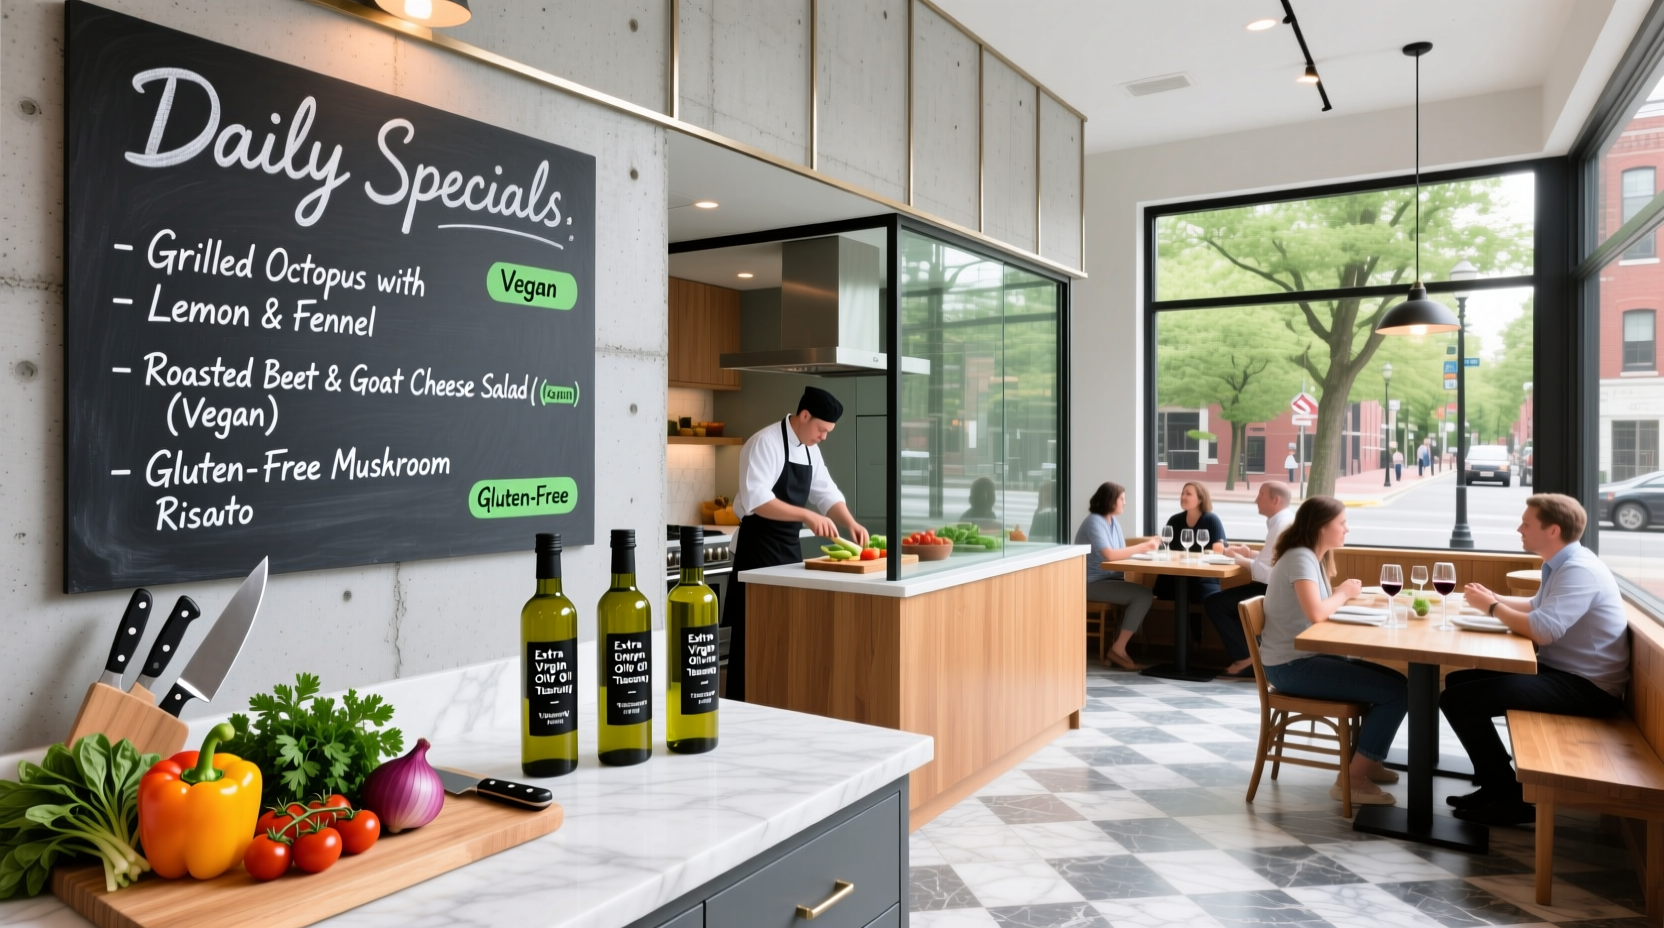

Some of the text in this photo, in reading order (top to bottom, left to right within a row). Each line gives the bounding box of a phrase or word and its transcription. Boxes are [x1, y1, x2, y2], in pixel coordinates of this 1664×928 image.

[125, 68, 350, 227] Daily
[148, 229, 256, 278] Grilled
[266, 248, 366, 301] Octopus
[378, 266, 424, 297] with
[500, 268, 557, 302] Vegan
[148, 284, 250, 327] Lemon
[262, 297, 282, 329] &
[293, 299, 376, 337] Fennel
[144, 352, 254, 390] Roasted
[264, 359, 319, 392] Beet
[325, 365, 341, 392] &
[350, 364, 404, 396] Goat
[410, 367, 475, 398] Cheese
[167, 392, 279, 439] (Vegan)
[146, 447, 321, 488] Gluten-Free
[477, 485, 569, 513] Gluten-Free
